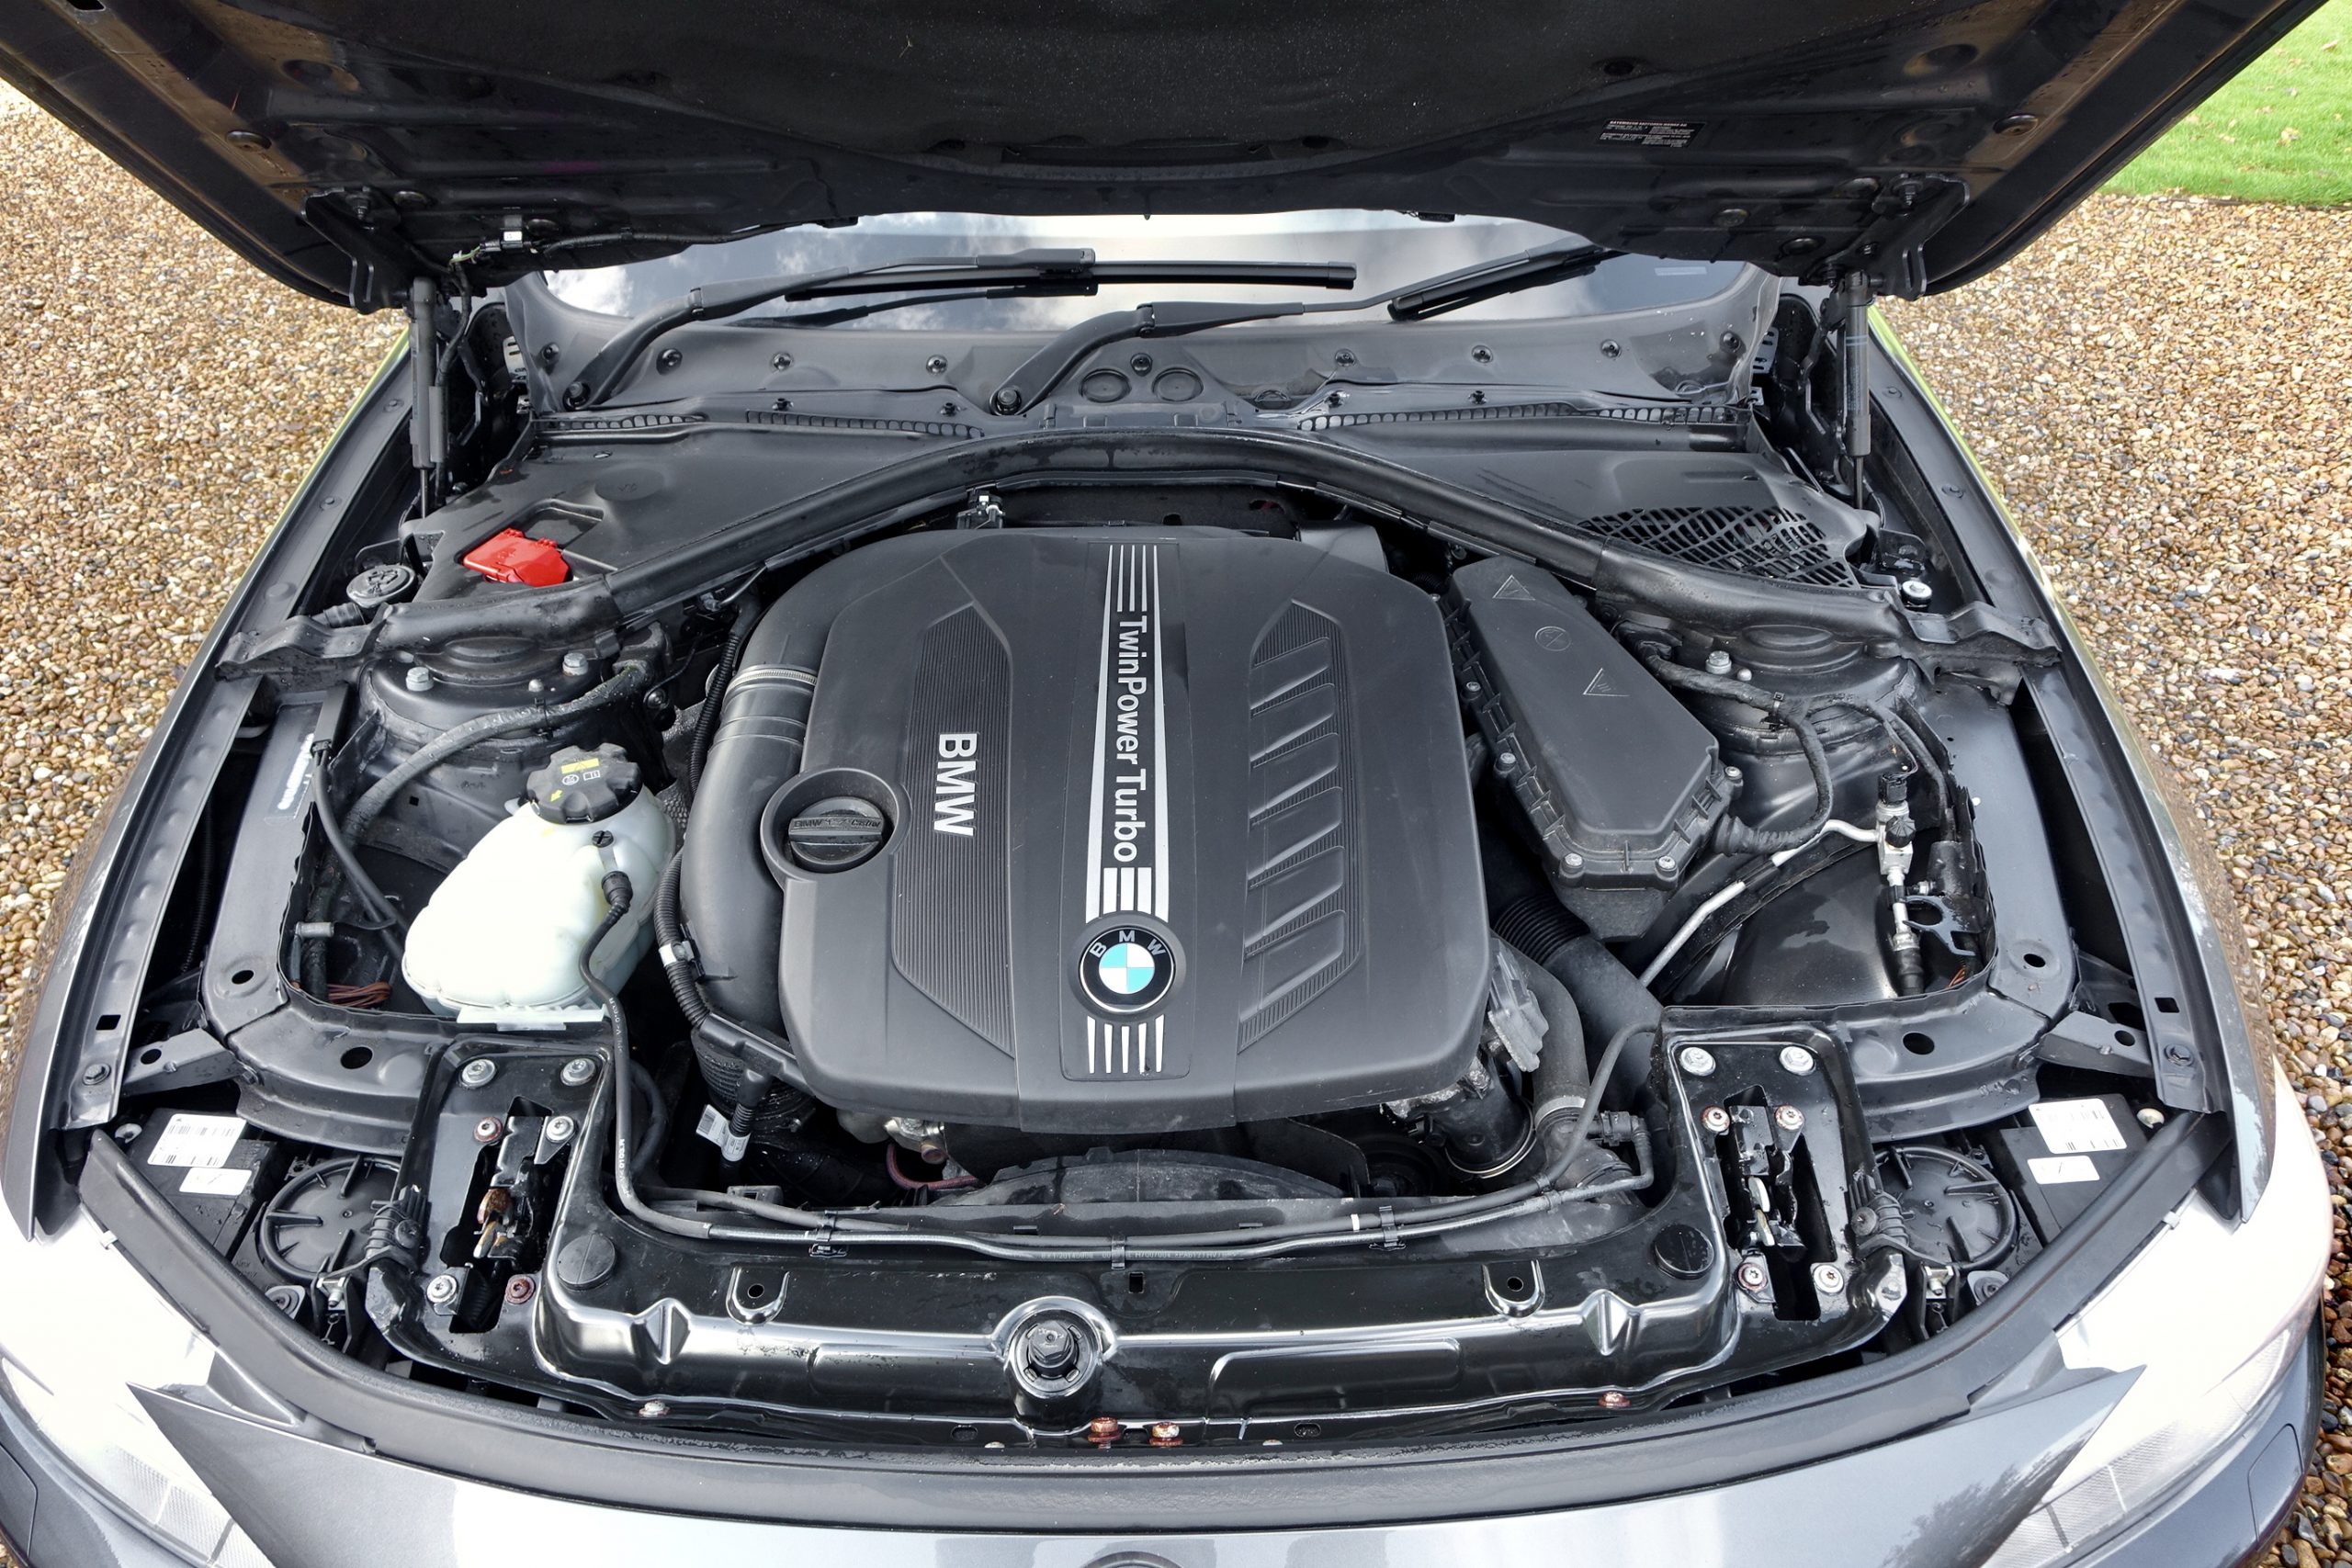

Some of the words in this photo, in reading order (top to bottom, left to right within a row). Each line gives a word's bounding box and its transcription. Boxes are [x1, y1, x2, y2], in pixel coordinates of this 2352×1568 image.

[1115, 615, 1148, 764] TwinPower
[933, 733, 978, 836] BMW
[1114, 768, 1147, 863] Turbo
[1089, 930, 1166, 958] BMW
